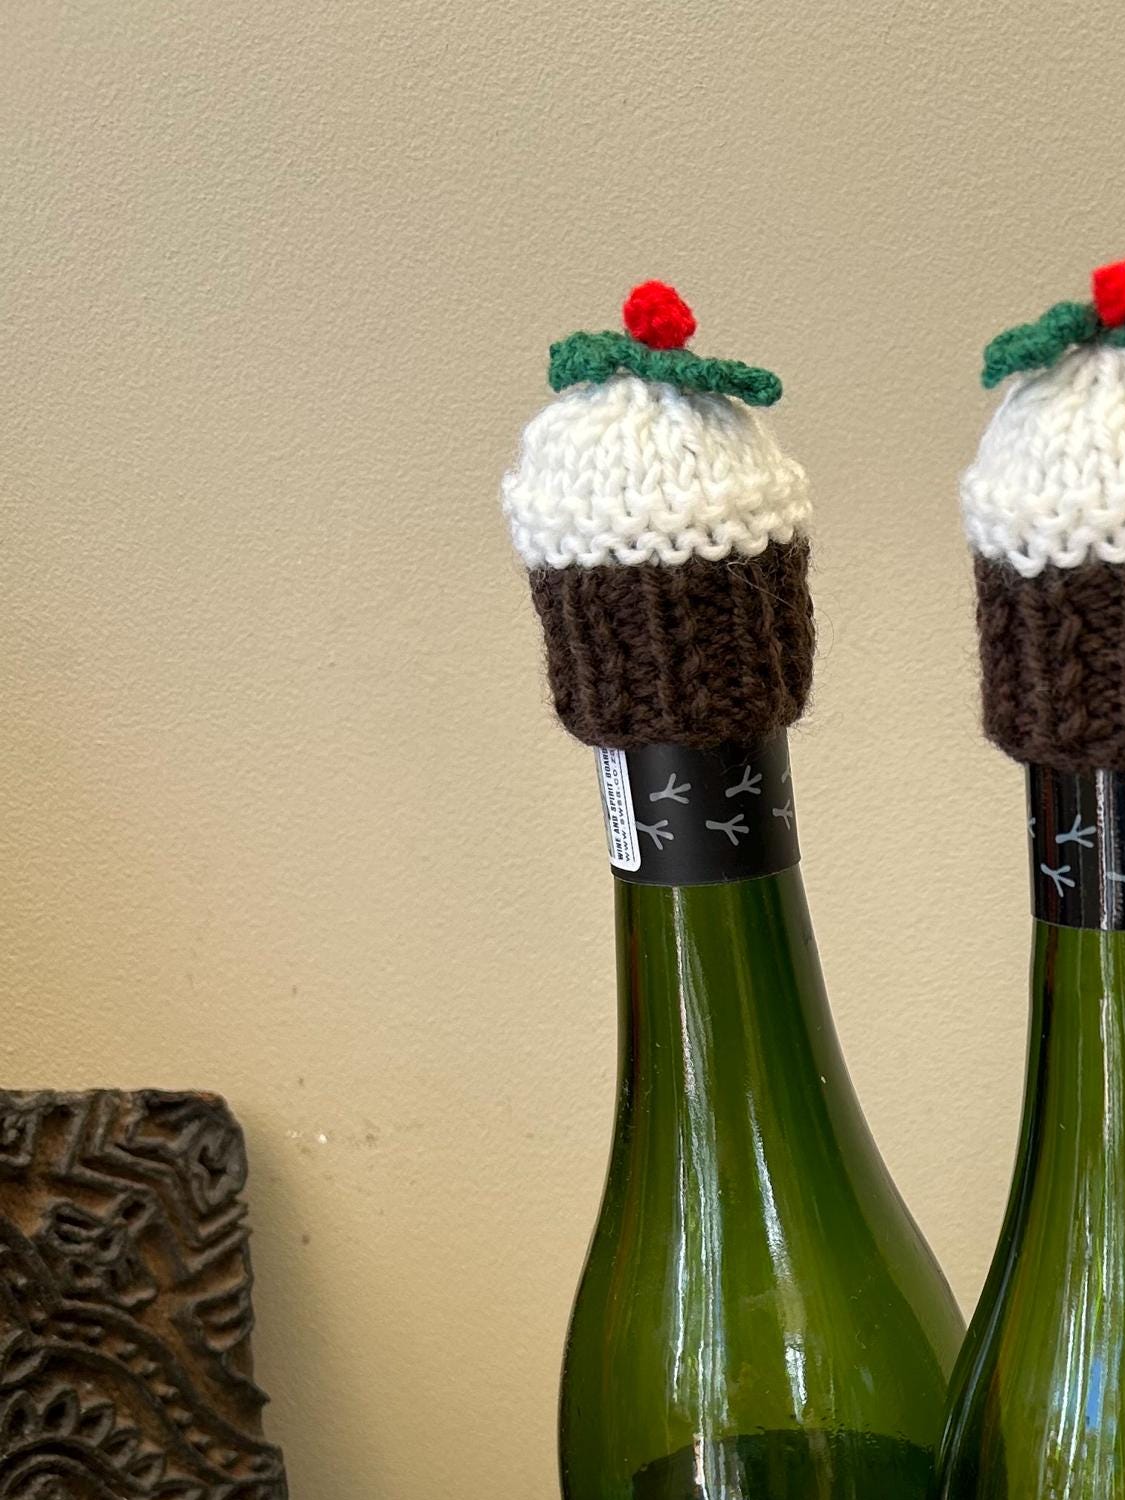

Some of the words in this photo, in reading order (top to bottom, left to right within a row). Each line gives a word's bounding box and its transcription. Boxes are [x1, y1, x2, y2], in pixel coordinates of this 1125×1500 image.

[602, 748, 611, 778] BOARD
[606, 781, 617, 812] SPIRIT
[611, 816, 620, 835] AND
[615, 837, 624, 860] WINE
